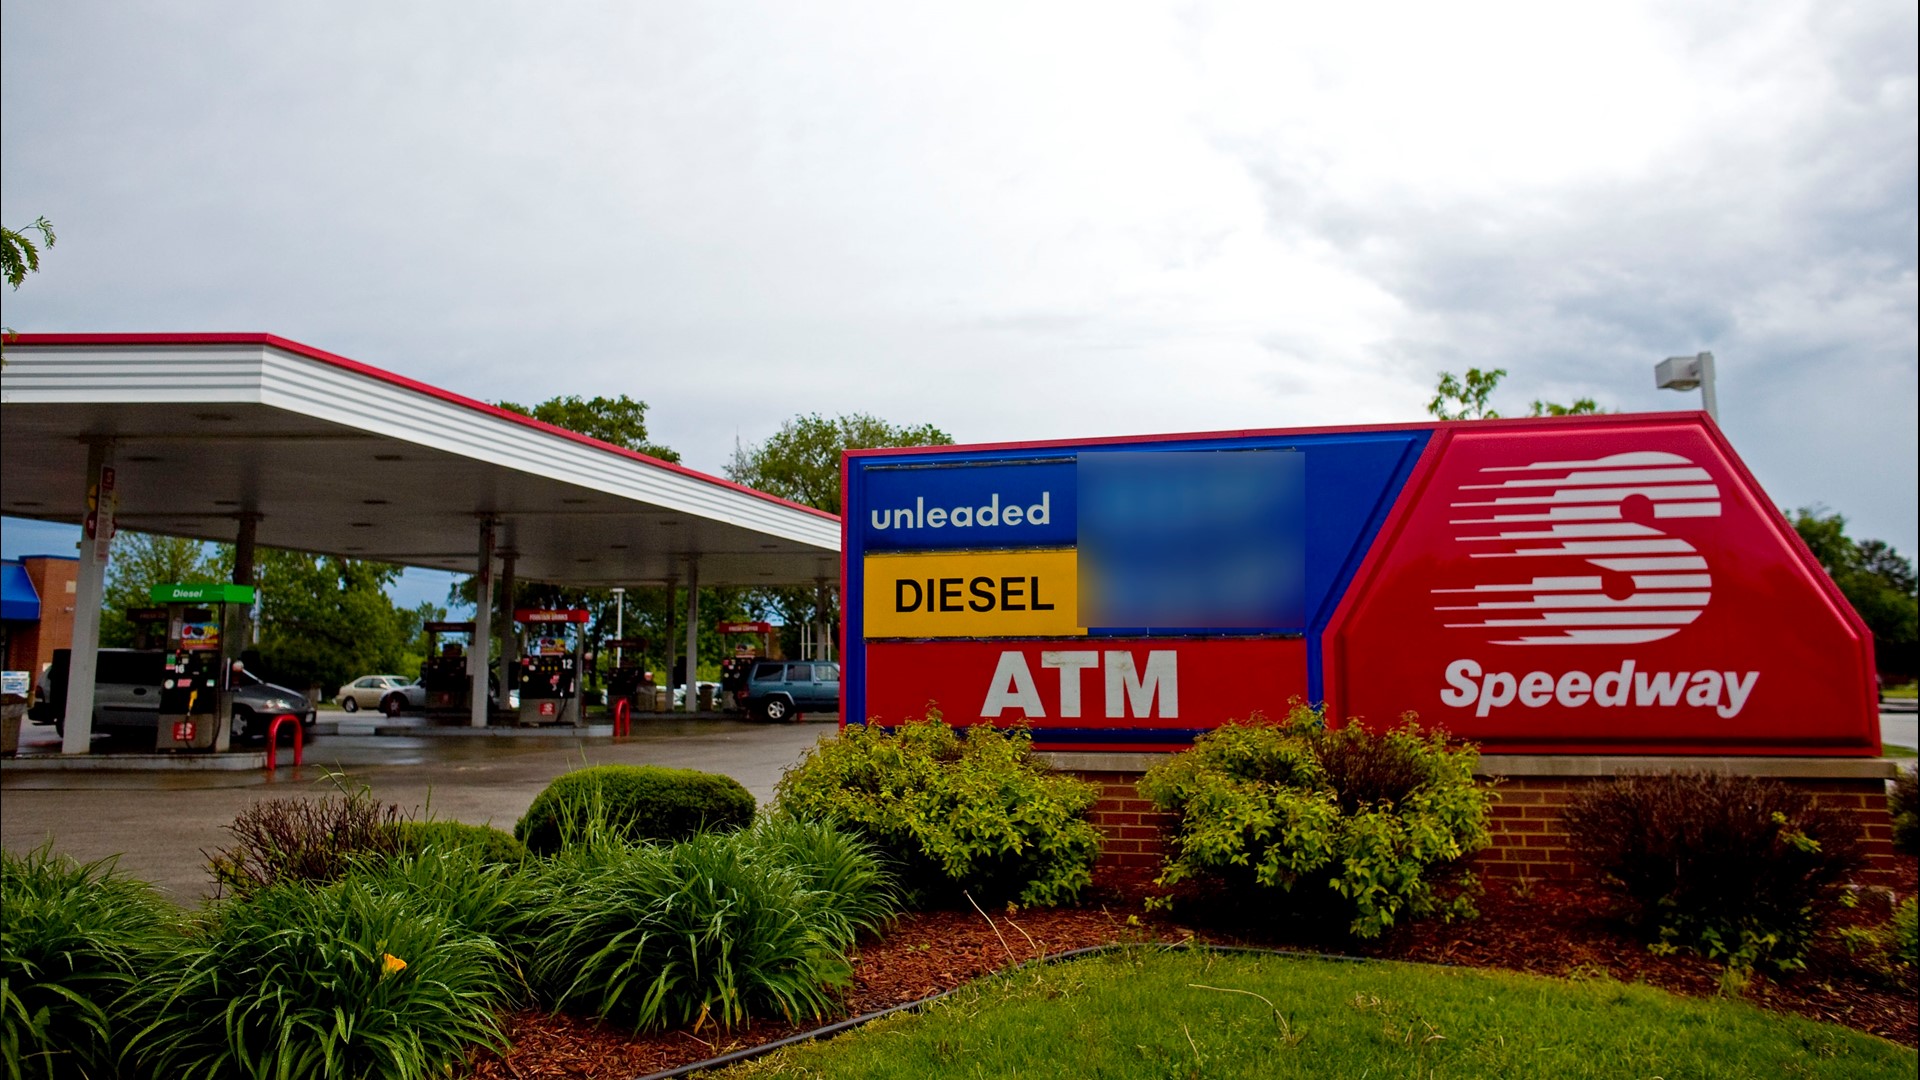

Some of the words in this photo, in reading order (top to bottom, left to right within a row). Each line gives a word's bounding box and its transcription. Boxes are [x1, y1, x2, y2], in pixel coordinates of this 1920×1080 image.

[870, 491, 1051, 531] unleaded
[172, 589, 203, 599] Diesel
[895, 576, 1055, 614] DIESEL
[175, 664, 185, 674] 16
[561, 658, 573, 669] 12
[980, 649, 1179, 719] ATM
[1440, 658, 1759, 719] Speedway
